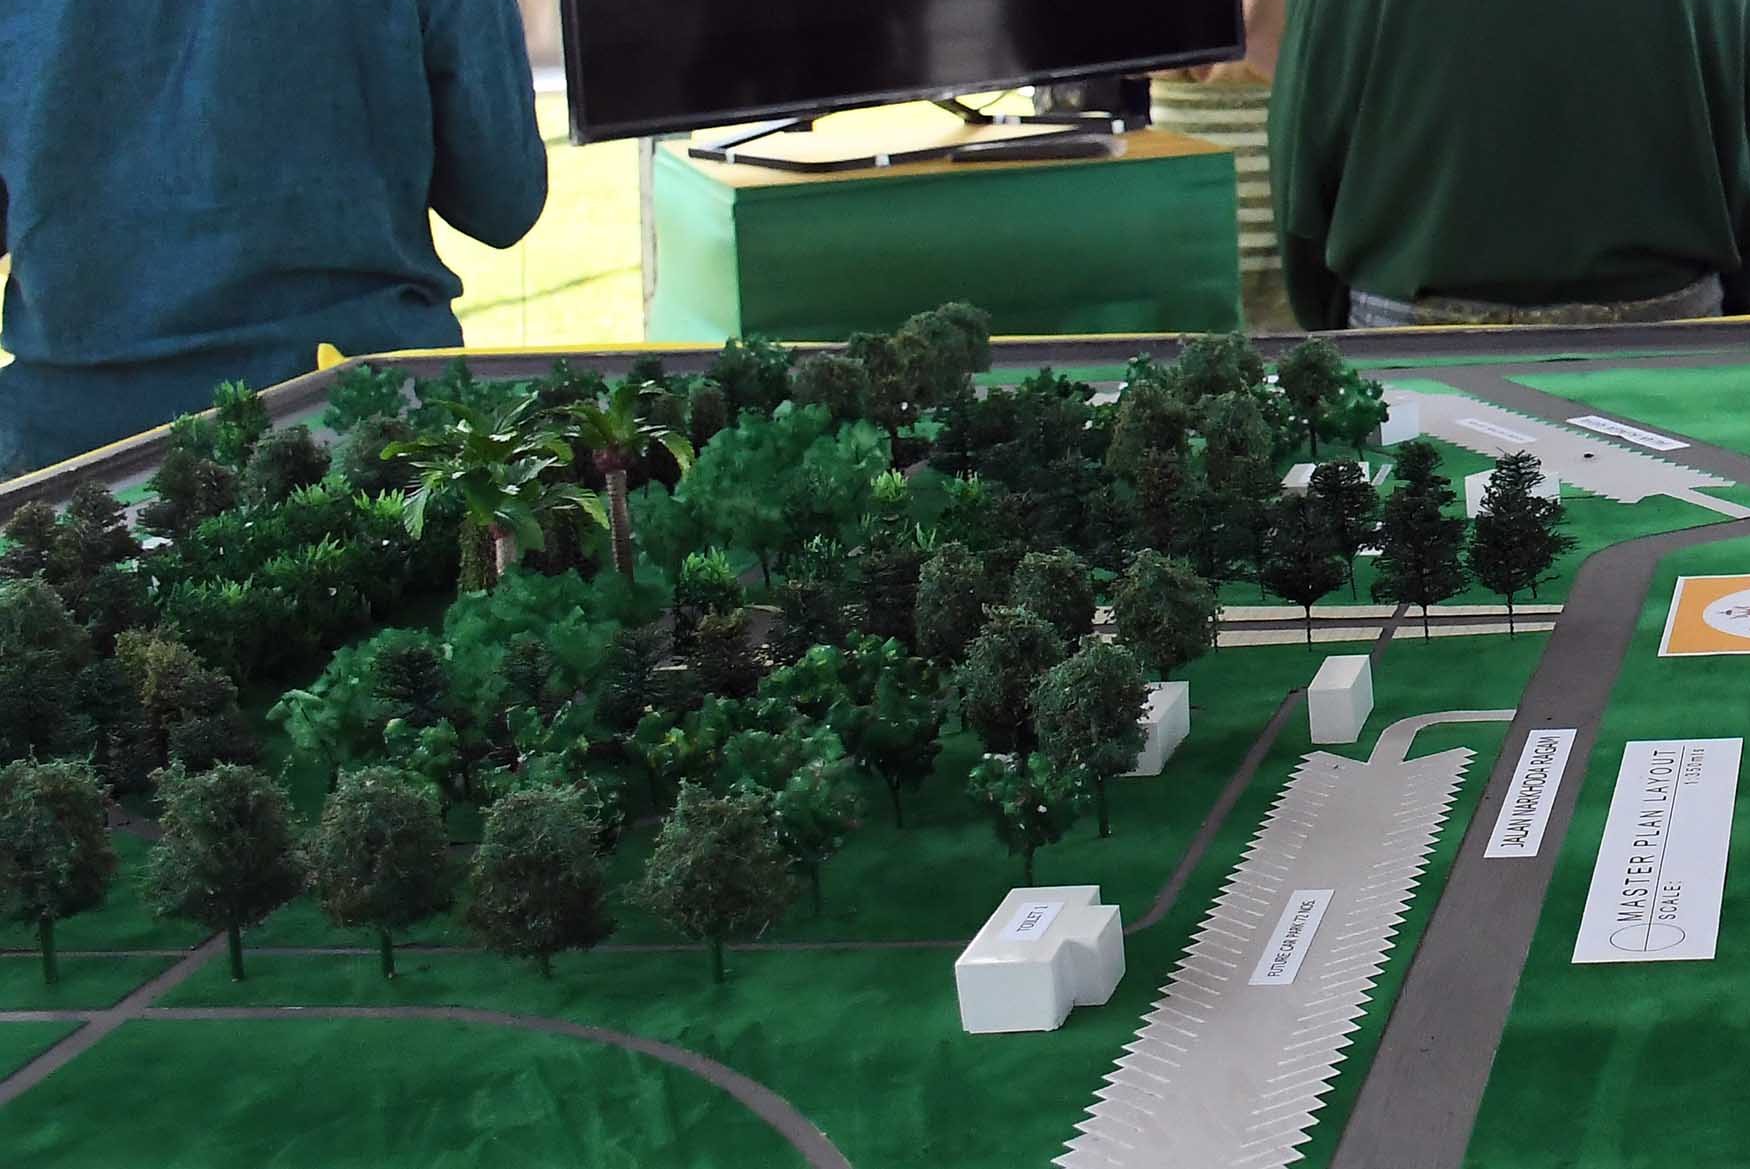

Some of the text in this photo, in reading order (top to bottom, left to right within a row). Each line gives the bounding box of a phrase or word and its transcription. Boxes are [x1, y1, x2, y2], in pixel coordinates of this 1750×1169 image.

[1500, 736, 1560, 848] JALAN NARKHODA RAGAM
[1616, 749, 1676, 922] MASTER PLAN LAYOUT
[1658, 880, 1683, 920] SCALE:
[1016, 912, 1043, 932] TOILET
[1285, 922, 1305, 938] PARK
[1280, 939, 1297, 952] CAR
[1267, 952, 1292, 977] FUTURE
